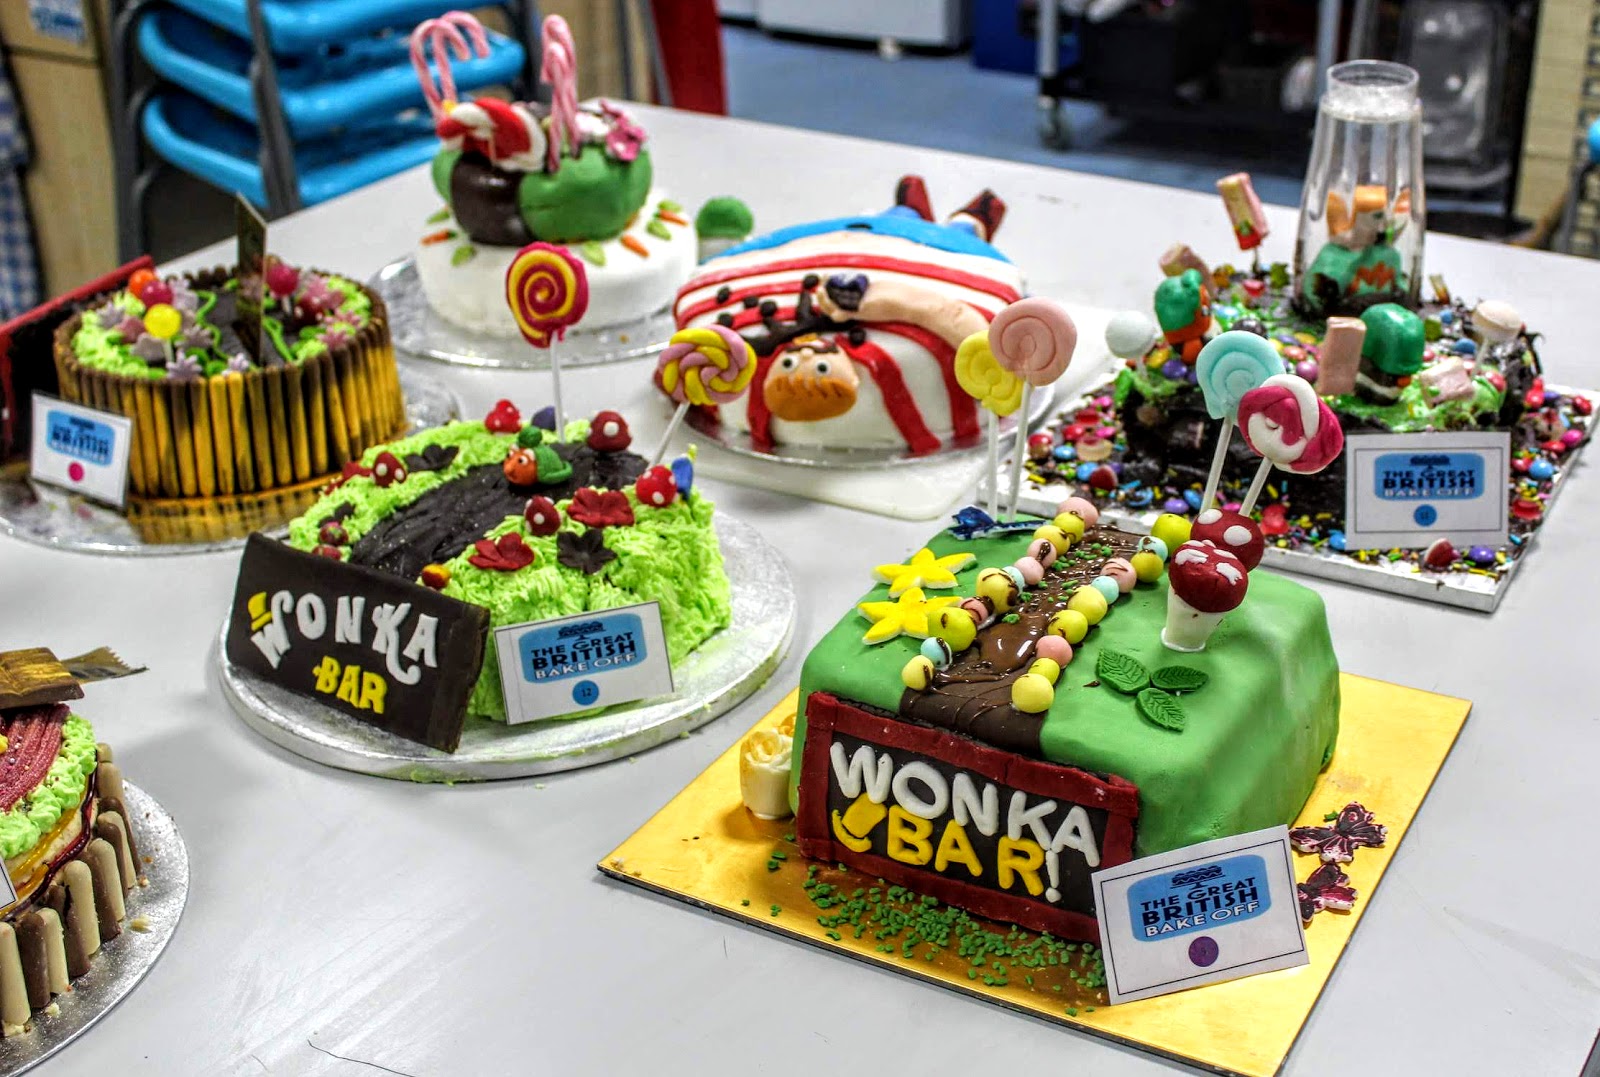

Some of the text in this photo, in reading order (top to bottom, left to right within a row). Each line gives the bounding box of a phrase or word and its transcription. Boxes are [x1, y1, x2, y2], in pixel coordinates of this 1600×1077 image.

[1383, 469, 1475, 479] THE GREAT
[1383, 477, 1476, 489] BRITISH
[1384, 488, 1475, 497] BAKE OFF
[251, 590, 439, 685] WONKA
[531, 632, 634, 658] THE GREAT
[532, 640, 636, 670] BRITISH
[535, 652, 637, 681] BAKE OFF
[312, 655, 388, 714] BAR
[581, 688, 592, 697] 12
[830, 741, 1100, 868] WONKA
[1141, 877, 1256, 911] THE GREAT
[1142, 887, 1259, 926] BRITISH
[1144, 901, 1260, 938] BAKE OFF
